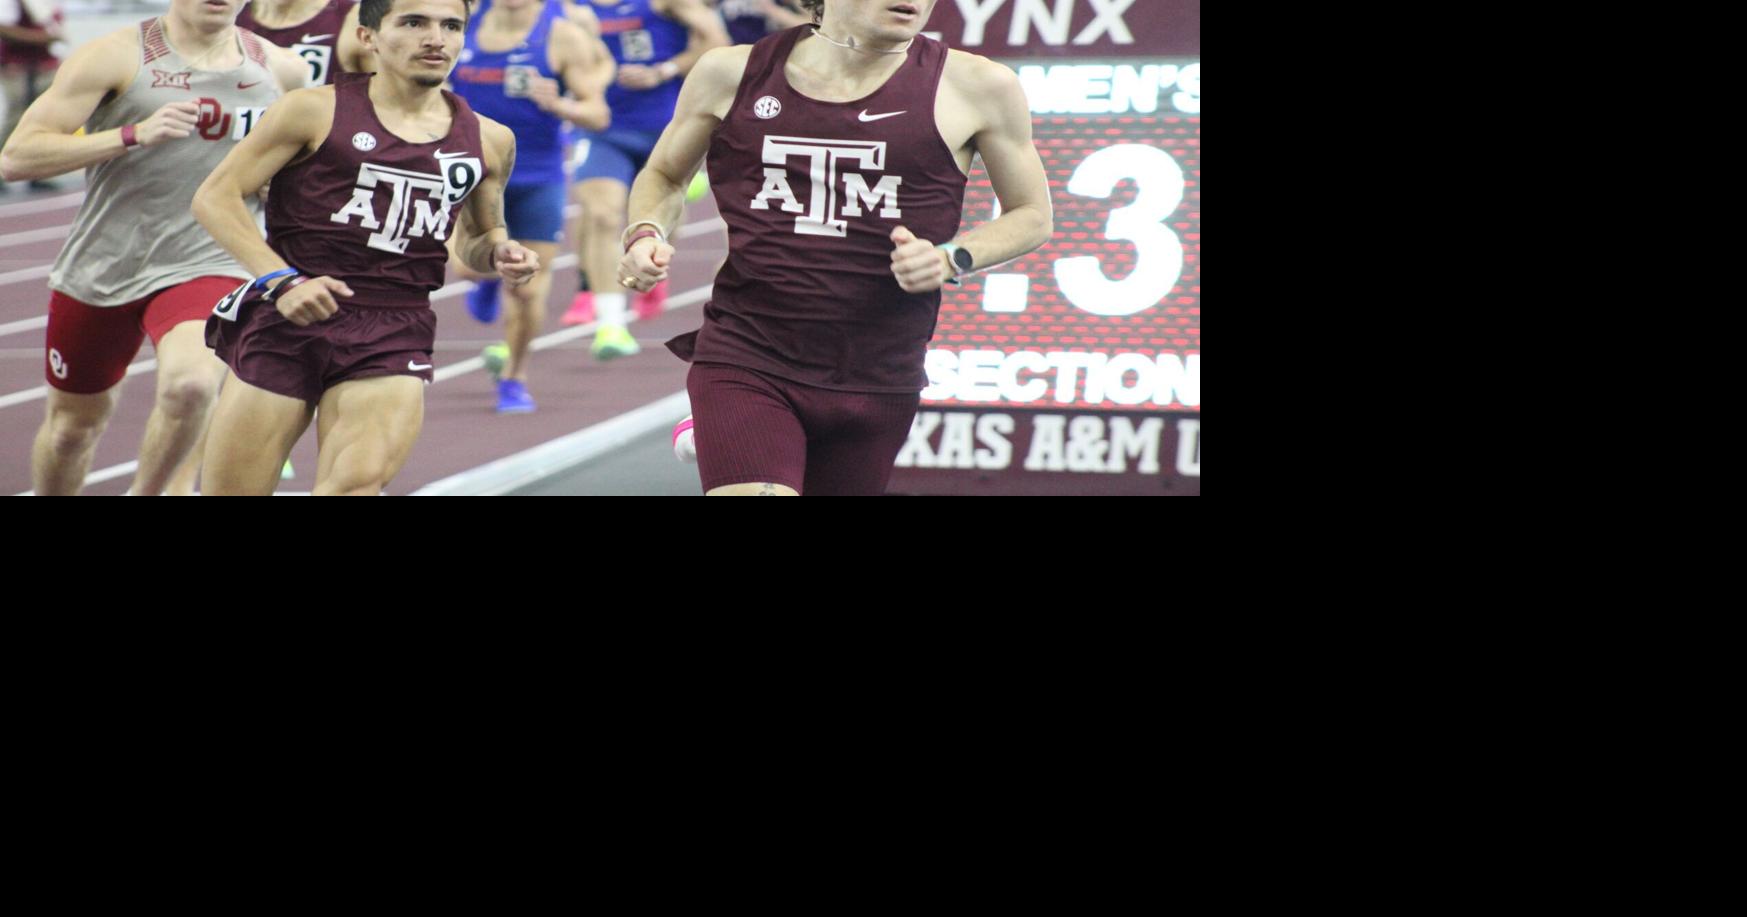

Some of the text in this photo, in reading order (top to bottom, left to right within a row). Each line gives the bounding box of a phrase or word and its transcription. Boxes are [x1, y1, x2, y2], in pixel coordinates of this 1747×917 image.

[920, 0, 1135, 46] YNX
[241, 109, 265, 138] 1
[754, 96, 781, 119] SEC
[448, 162, 475, 202] 9
[920, 350, 1200, 405] SECTION
[1024, 415, 1163, 474] A&M
